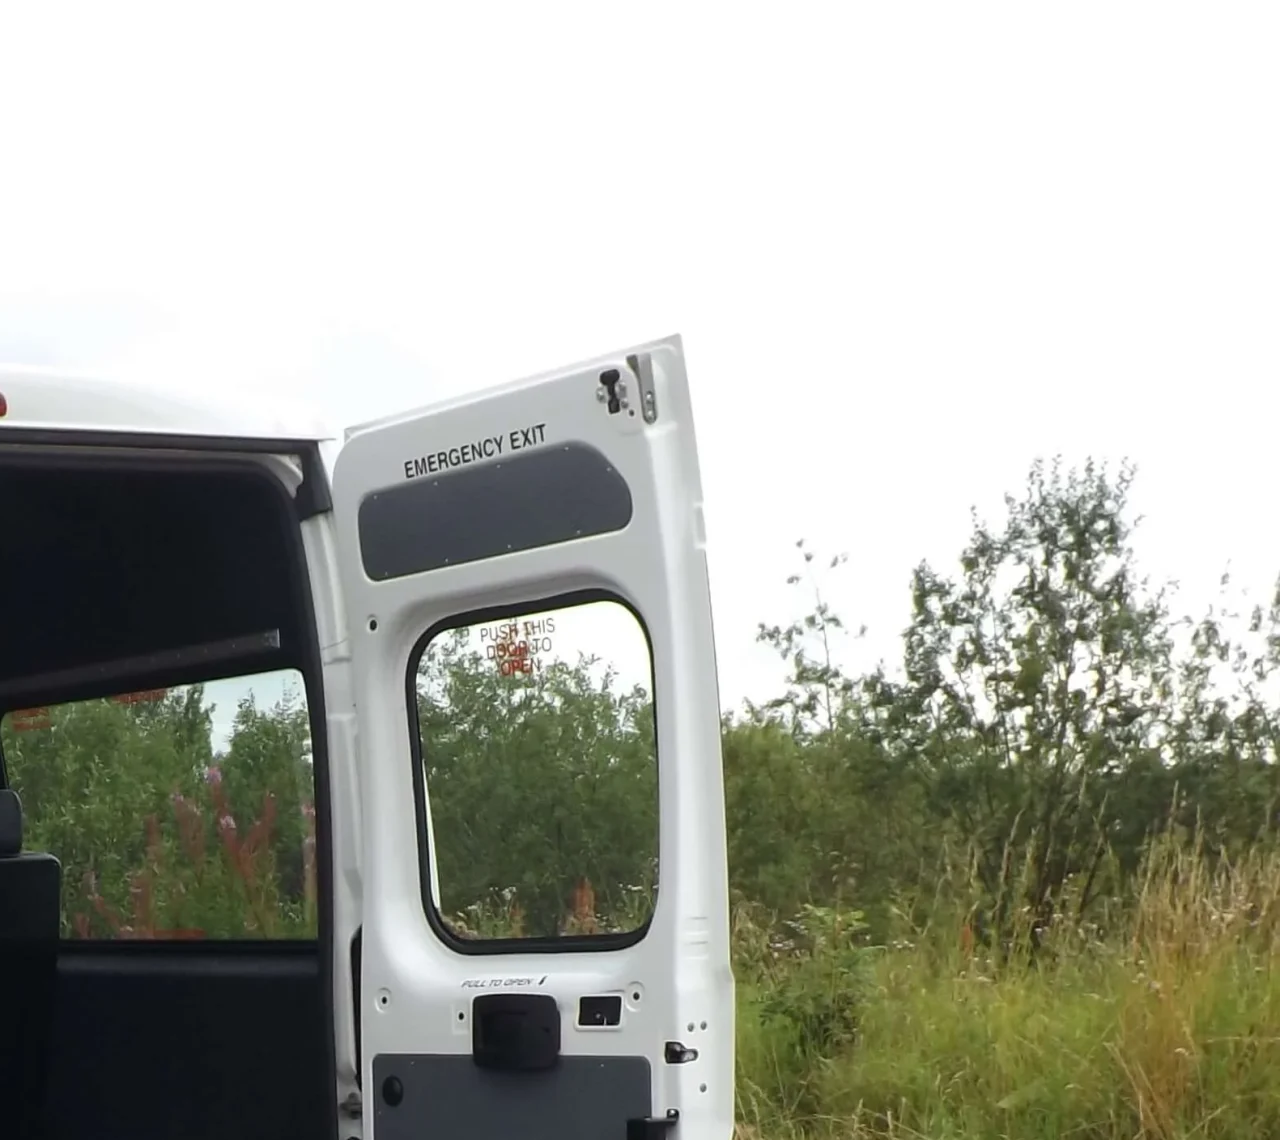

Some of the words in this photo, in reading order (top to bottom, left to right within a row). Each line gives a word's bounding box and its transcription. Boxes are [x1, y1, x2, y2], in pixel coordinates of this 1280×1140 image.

[404, 435, 503, 479] EMERGENCY
[510, 423, 546, 450] EXIT
[480, 623, 518, 642] PUSH
[524, 618, 555, 637] THIS
[487, 641, 528, 660] DOOR
[532, 637, 552, 653] TO
[501, 658, 540, 675] OPEN
[461, 979, 487, 988] PULL
[489, 979, 503, 987] TO
[503, 978, 534, 987] OPEN
